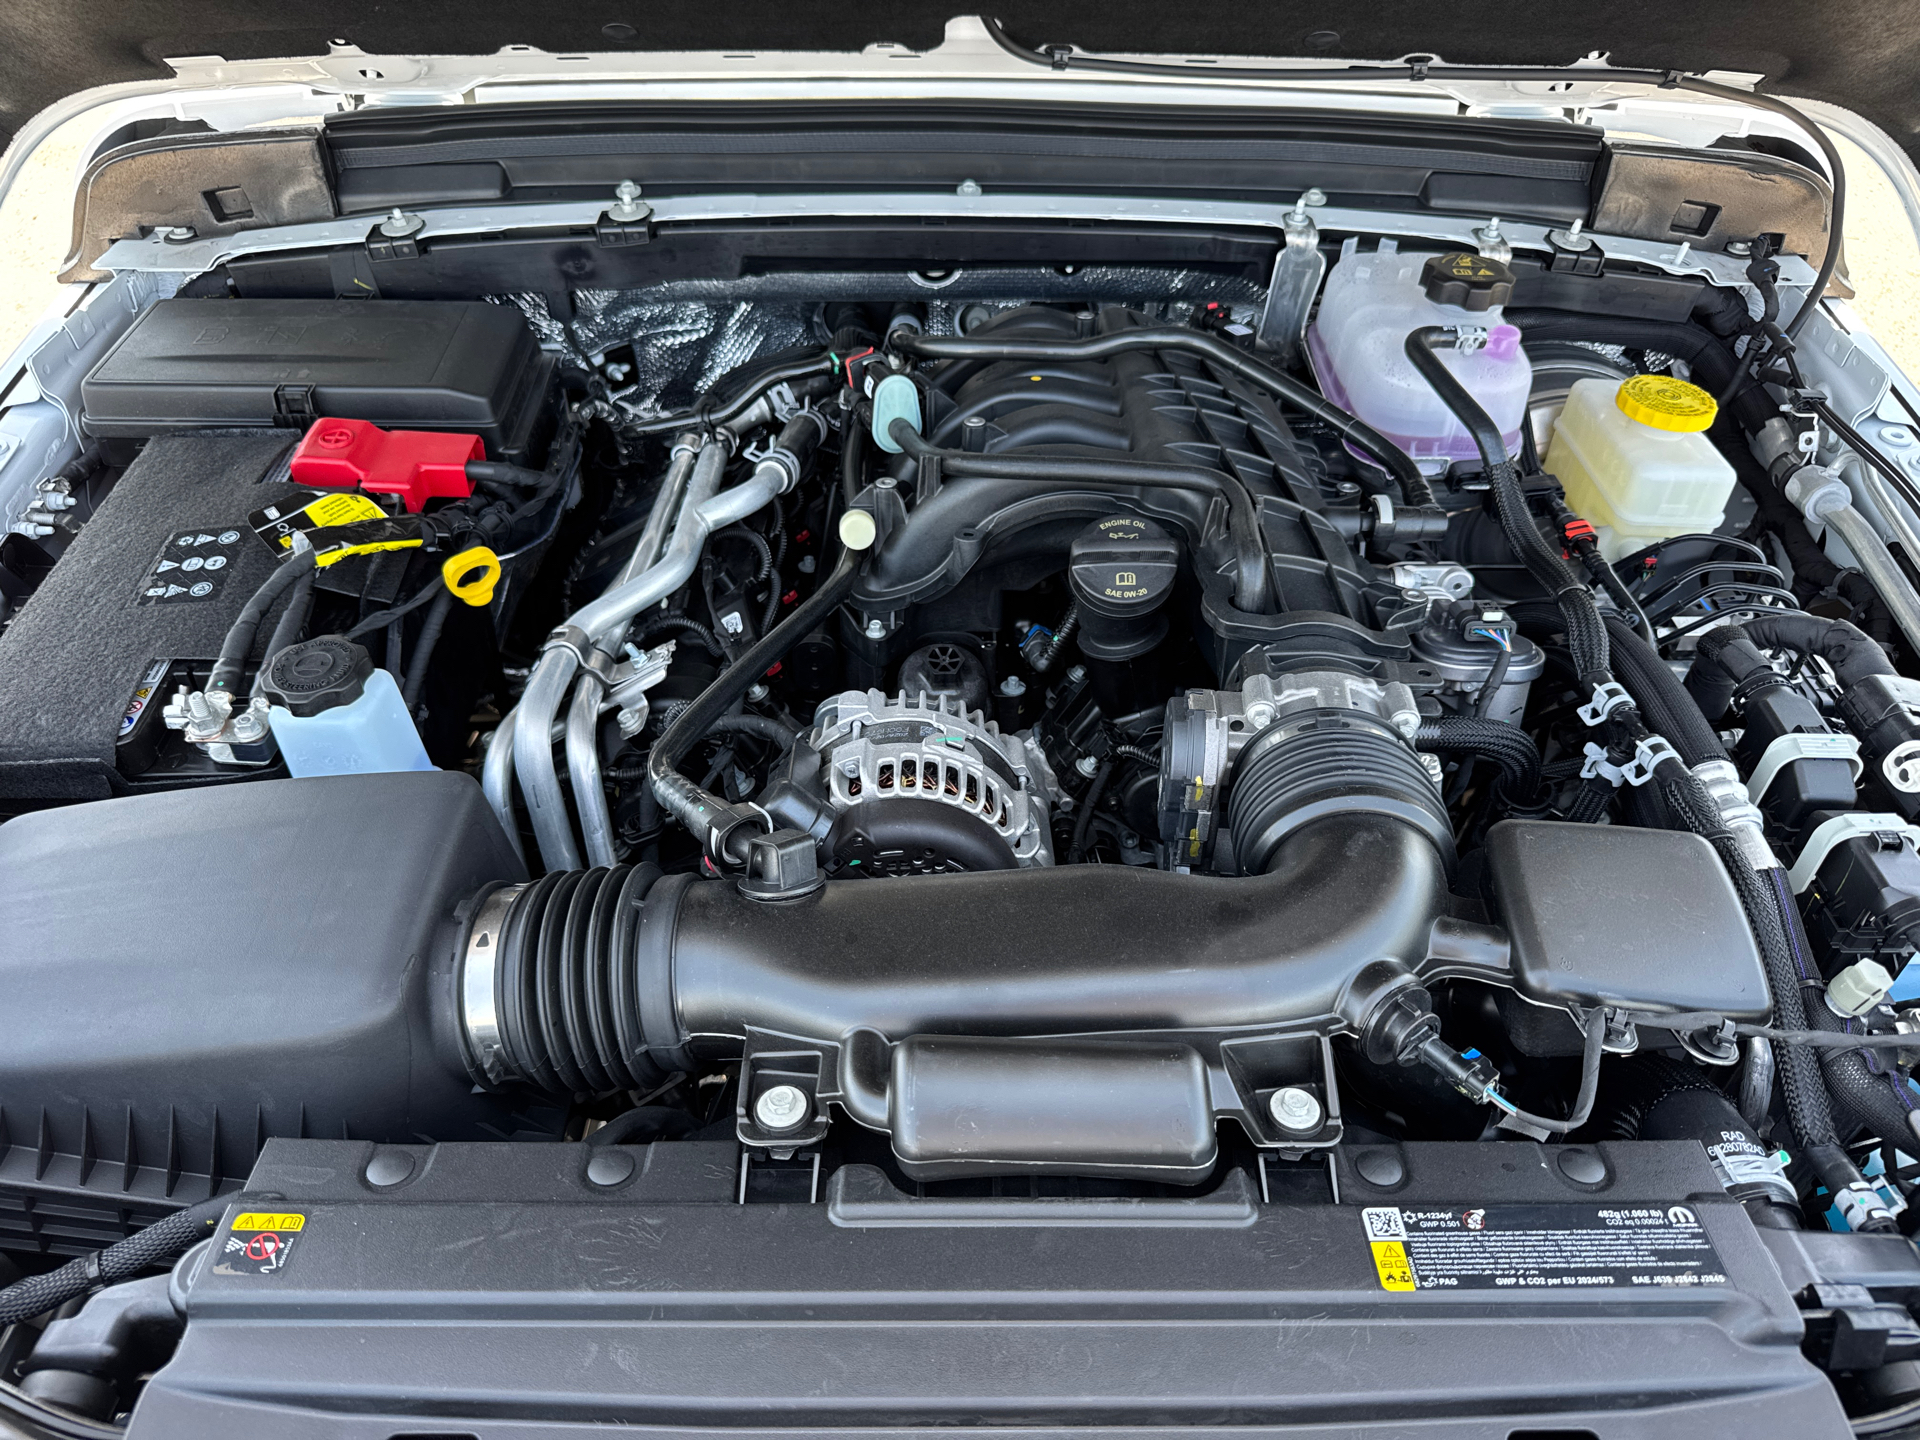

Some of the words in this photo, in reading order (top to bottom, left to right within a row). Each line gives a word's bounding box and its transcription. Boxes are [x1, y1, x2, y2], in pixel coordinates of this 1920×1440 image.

[1099, 519, 1131, 530] ENGINE
[1132, 520, 1146, 530] OIL
[1105, 588, 1122, 598] SAE
[1123, 587, 1148, 598] 0W-20
[1720, 1130, 1746, 1142] RAD
[1707, 1141, 1766, 1157] 6280782AD
[1417, 1211, 1453, 1221] R-1234yf
[1605, 1218, 1624, 1226] CO2
[1438, 1277, 1459, 1286] PAG
[1495, 1277, 1517, 1286] GWP
[1526, 1277, 1546, 1285] CO2
[1547, 1278, 1561, 1286] per
[1562, 1276, 1576, 1285] EU
[1631, 1275, 1652, 1284] SAE
